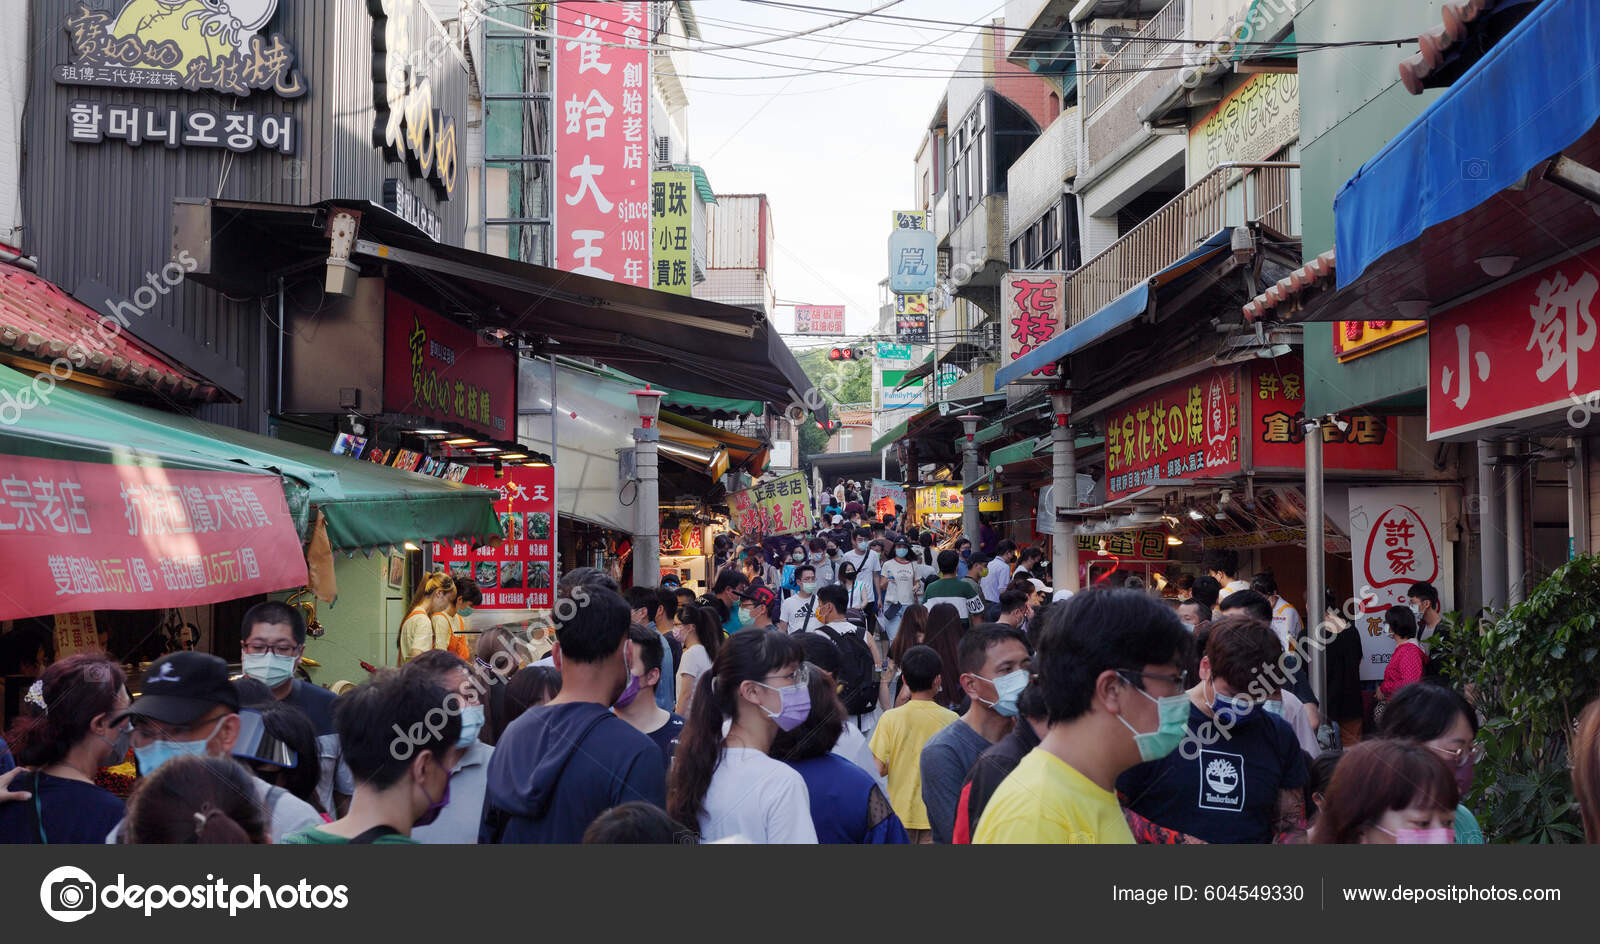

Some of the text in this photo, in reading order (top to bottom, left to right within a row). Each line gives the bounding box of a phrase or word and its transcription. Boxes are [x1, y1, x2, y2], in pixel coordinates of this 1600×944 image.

[62, 66, 178, 86] 祖傳三代好滋味
[70, 103, 292, 151] 할머니오징어
[618, 199, 648, 223] since
[621, 230, 645, 251] 1981
[623, 258, 643, 284] 年
[657, 260, 687, 286] 貴族
[884, 391, 922, 403] FamilyMart
[752, 478, 803, 503] 正宗老店
[1384, 518, 1416, 575] 許家
[1206, 792, 1239, 805] Timberland
